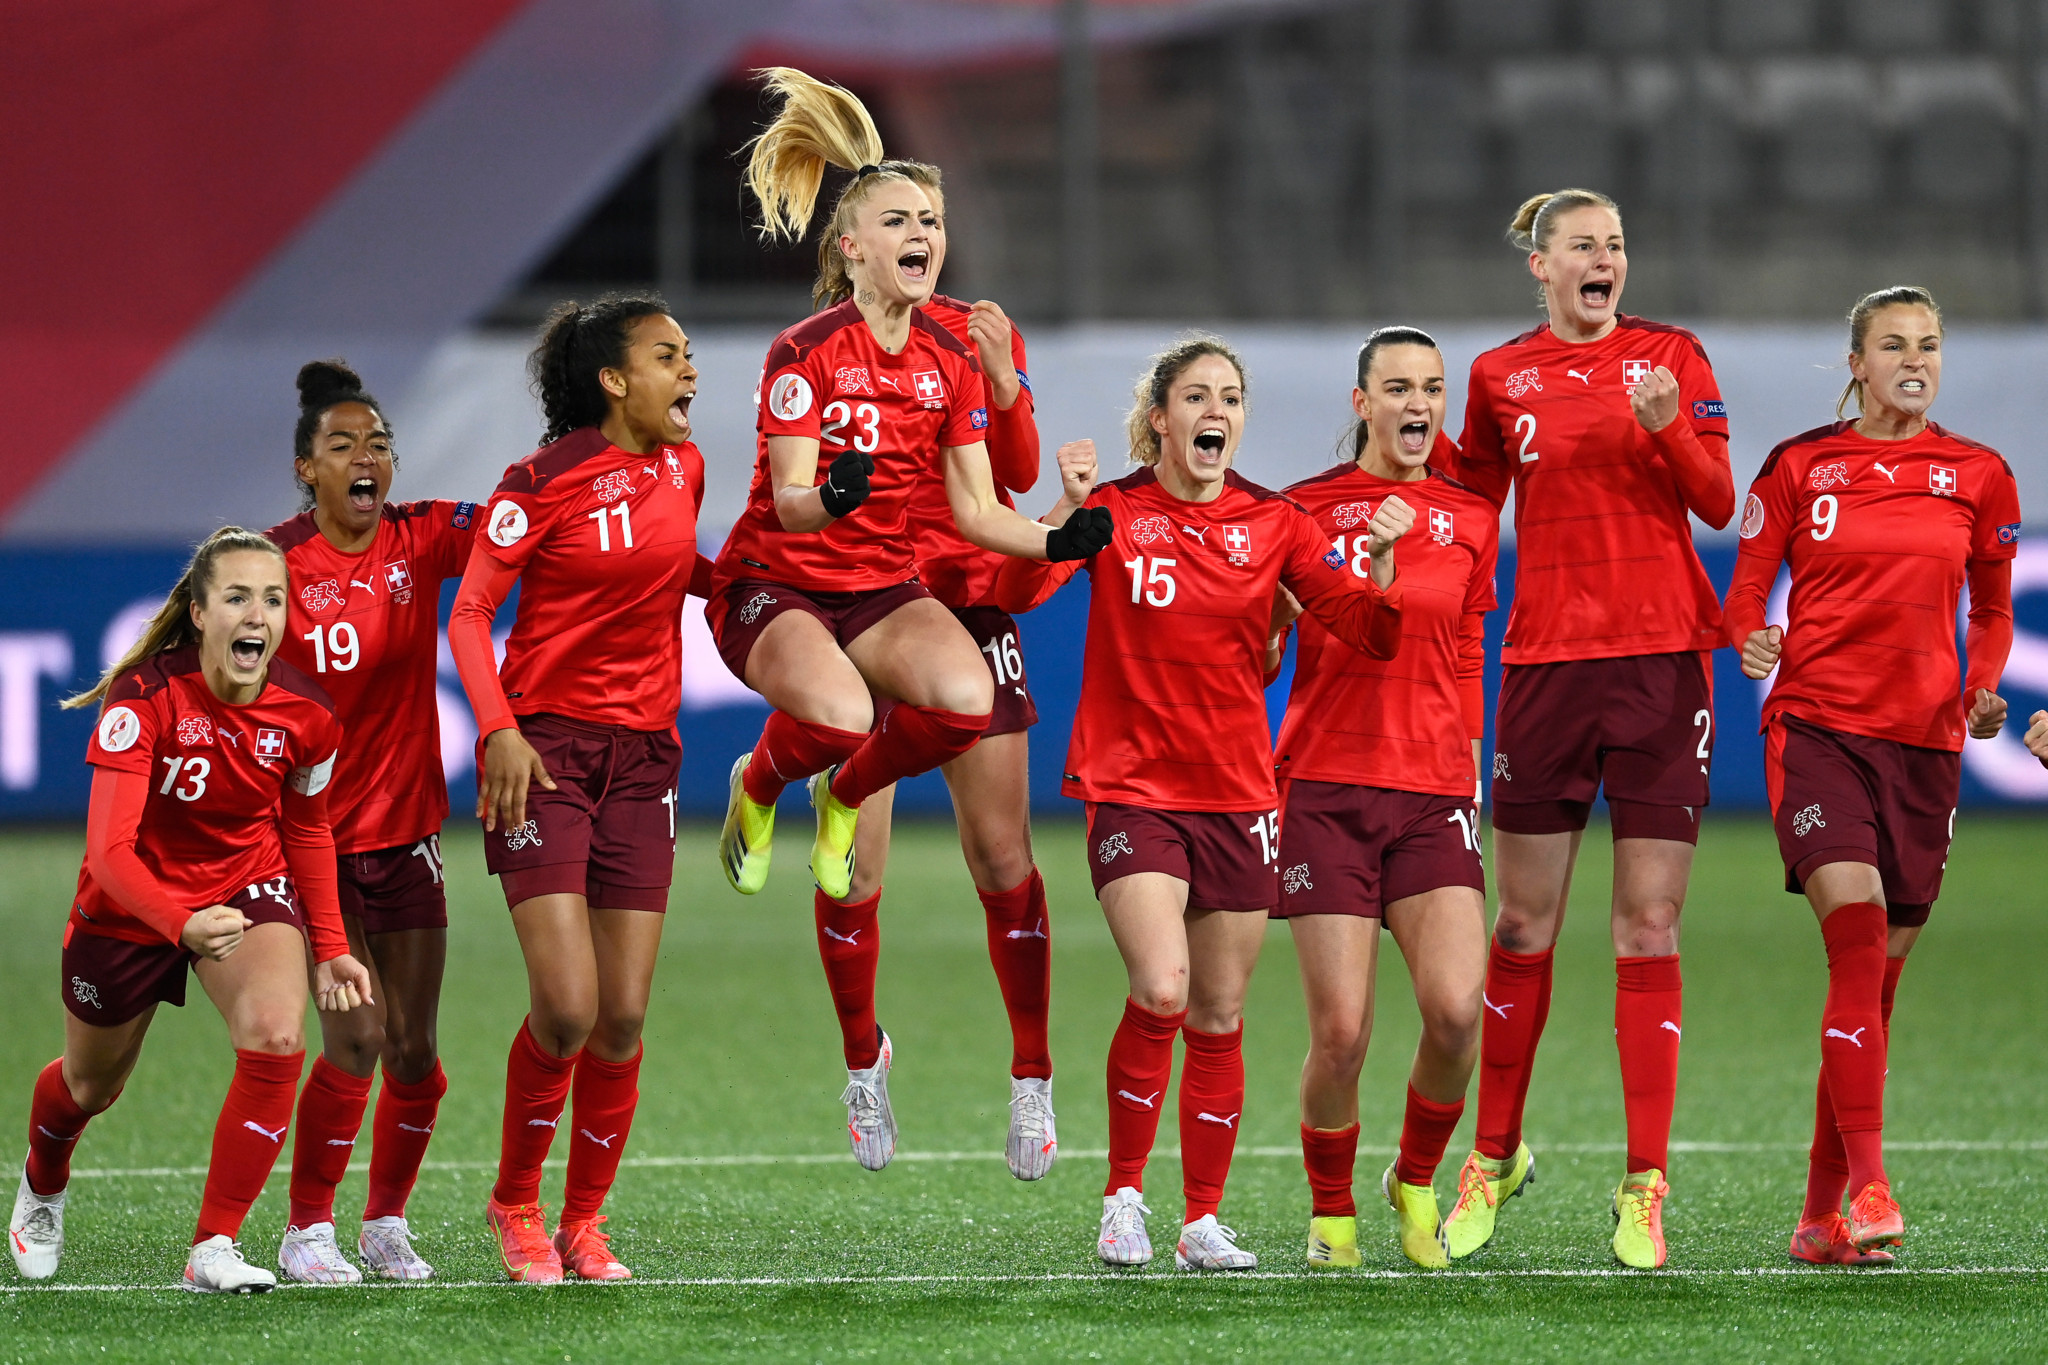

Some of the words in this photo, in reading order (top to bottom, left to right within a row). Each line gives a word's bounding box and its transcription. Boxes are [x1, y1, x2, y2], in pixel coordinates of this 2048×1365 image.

[820, 401, 881, 452] 23
[1515, 415, 1539, 464] 2
[588, 501, 633, 552] 11
[1812, 494, 1838, 541] 9
[1124, 556, 1177, 607] 15
[304, 622, 359, 672] 19
[982, 632, 1022, 685] 16
[1694, 709, 1710, 758] 2
[160, 757, 210, 801] 13
[1249, 809, 1279, 865] 15
